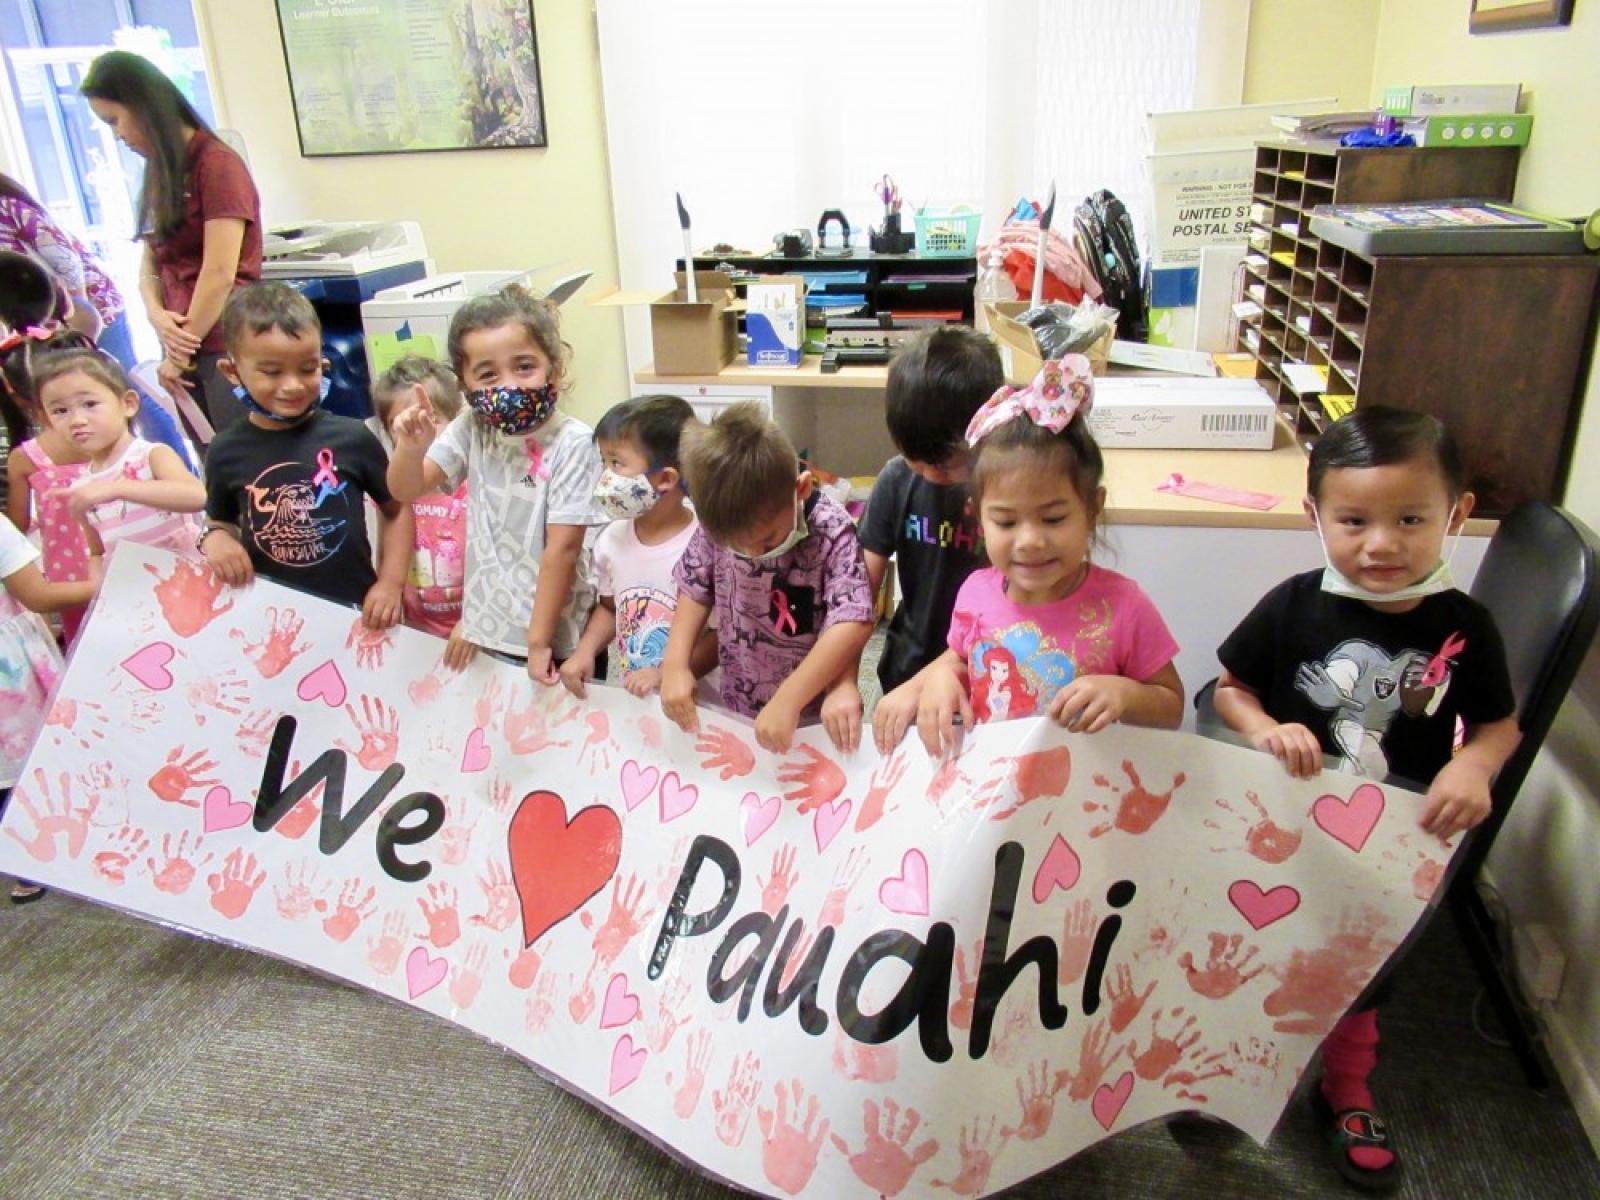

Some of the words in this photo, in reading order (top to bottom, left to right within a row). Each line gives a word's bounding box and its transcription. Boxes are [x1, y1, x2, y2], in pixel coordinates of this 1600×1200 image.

[1179, 207, 1232, 221] UNITED
[1173, 223, 1229, 238] POSTAL
[252, 714, 446, 882] We
[647, 834, 1137, 1063] Pauahi
